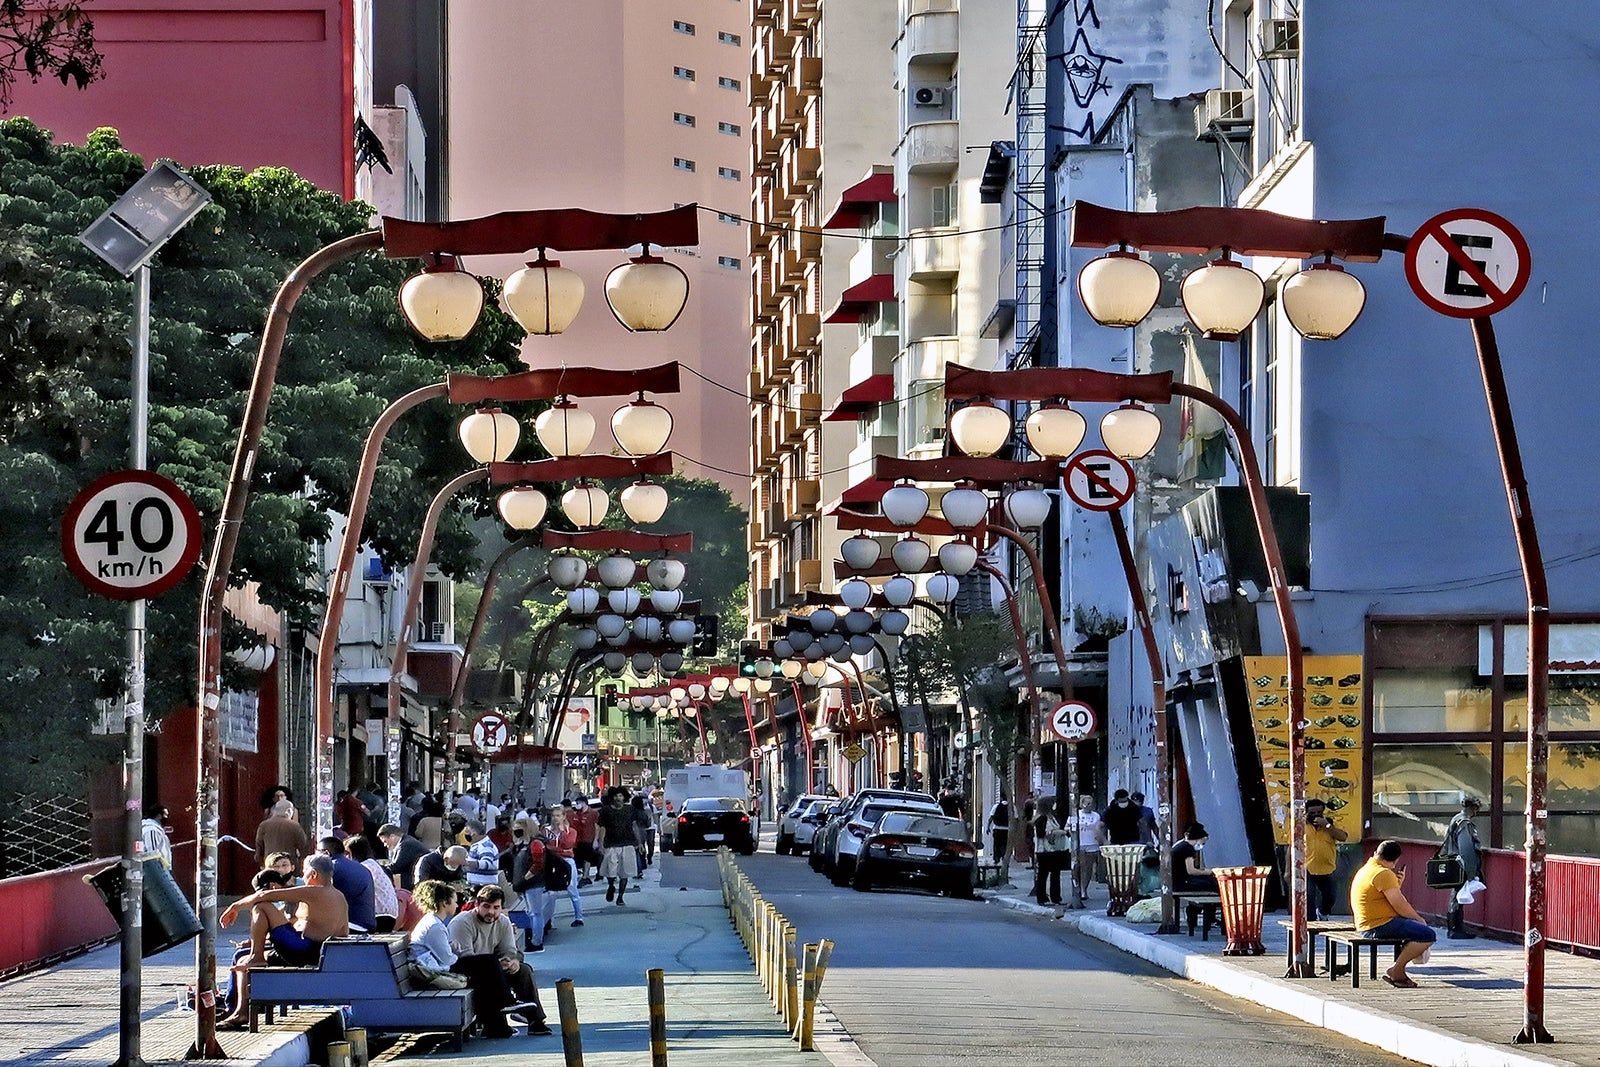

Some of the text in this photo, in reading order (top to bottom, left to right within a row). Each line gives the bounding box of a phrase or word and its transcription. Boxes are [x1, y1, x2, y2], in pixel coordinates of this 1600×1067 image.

[1443, 233, 1493, 298] E
[1086, 463, 1113, 498] E
[84, 497, 173, 555] 40
[98, 555, 163, 577] km/h
[1057, 711, 1088, 727] 40
